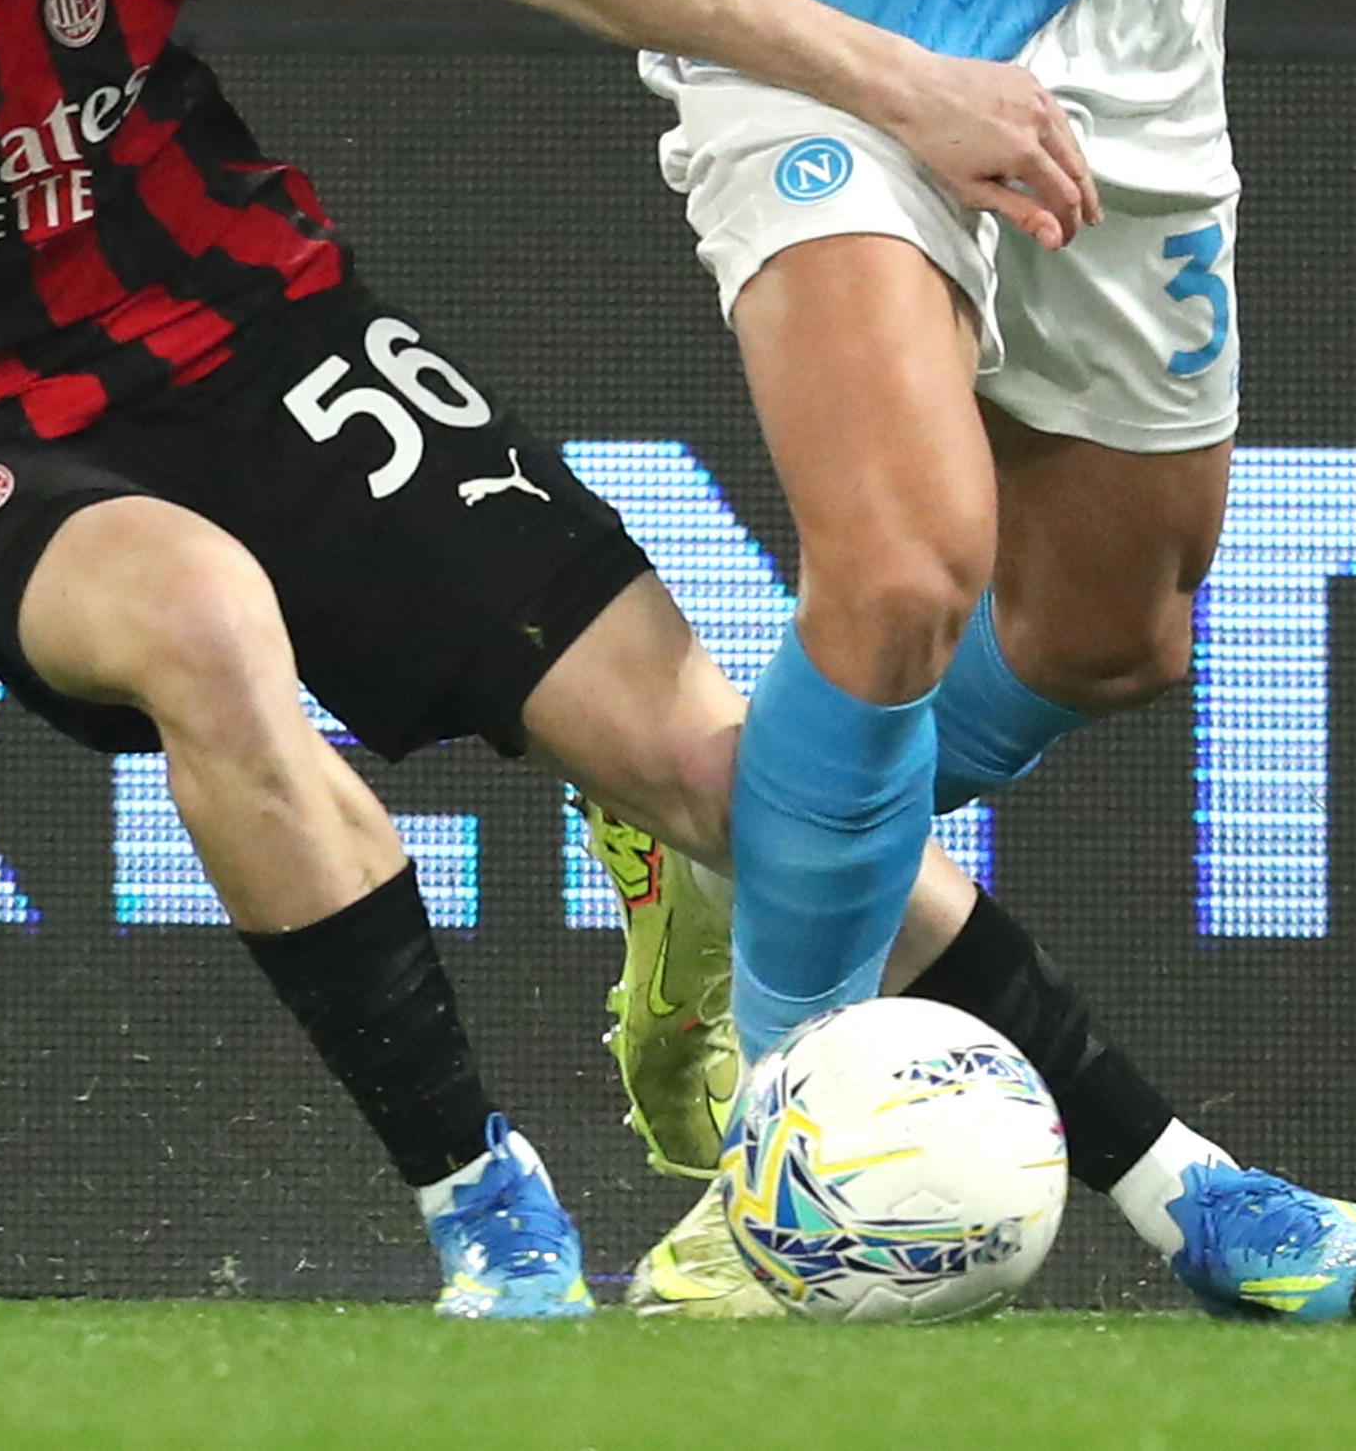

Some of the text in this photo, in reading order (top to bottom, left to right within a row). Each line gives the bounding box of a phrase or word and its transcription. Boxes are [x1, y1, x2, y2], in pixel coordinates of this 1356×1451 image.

[794, 152, 833, 191] N
[1162, 222, 1229, 376] 3
[282, 316, 492, 499] 56
